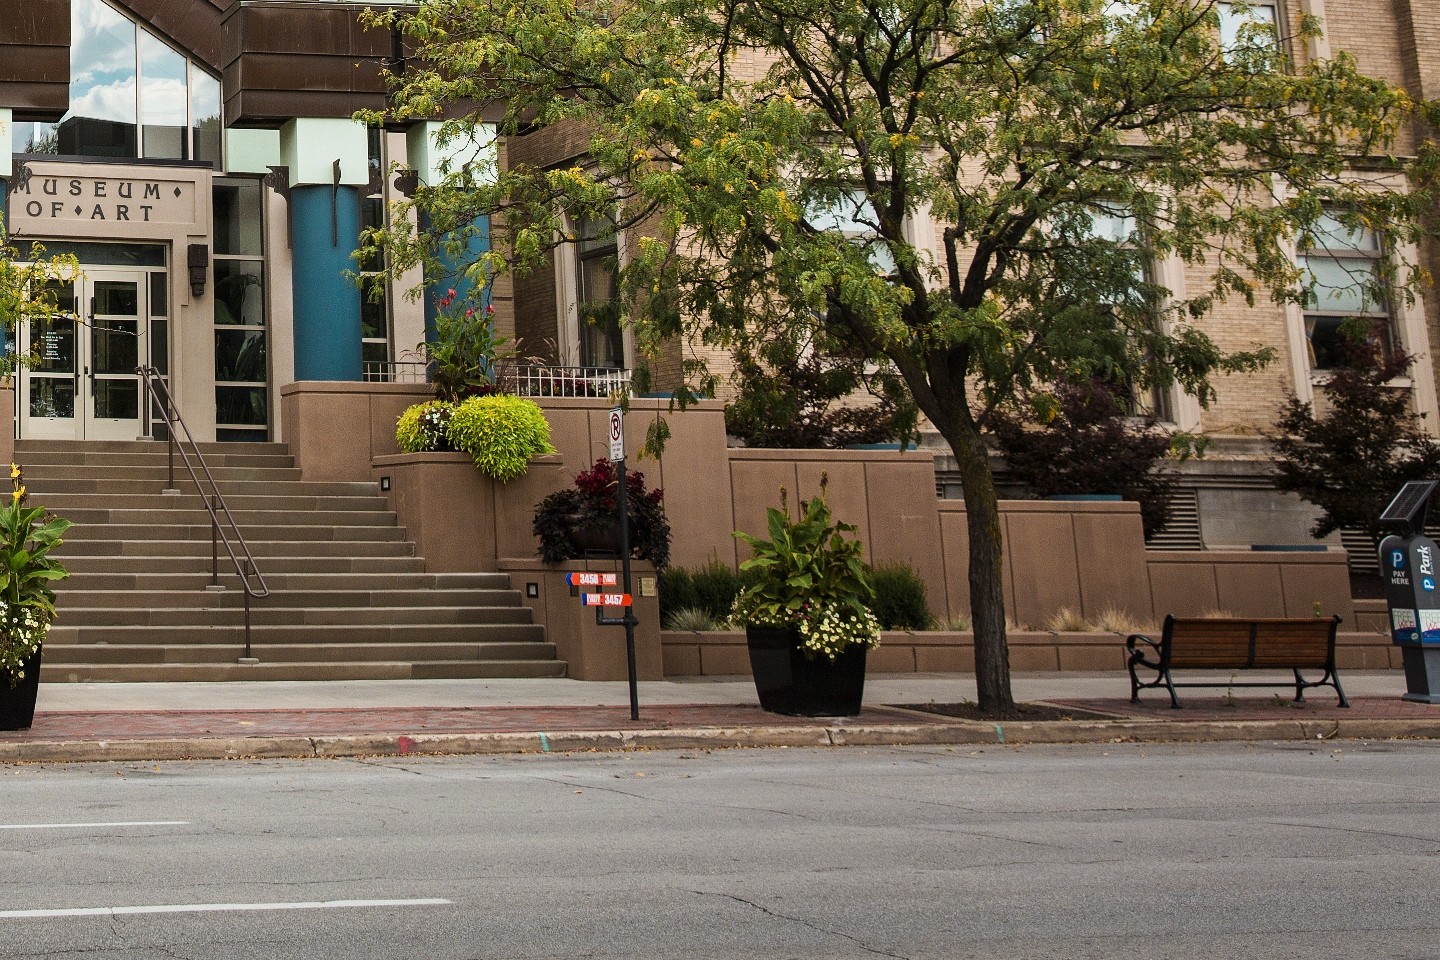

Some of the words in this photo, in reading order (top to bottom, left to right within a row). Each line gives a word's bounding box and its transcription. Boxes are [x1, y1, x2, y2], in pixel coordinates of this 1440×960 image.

[13, 178, 161, 200] MUSEUM
[26, 200, 64, 218] OF
[91, 204, 153, 222] ART
[1417, 545, 1432, 575] Park
[604, 594, 623, 605] 3457
